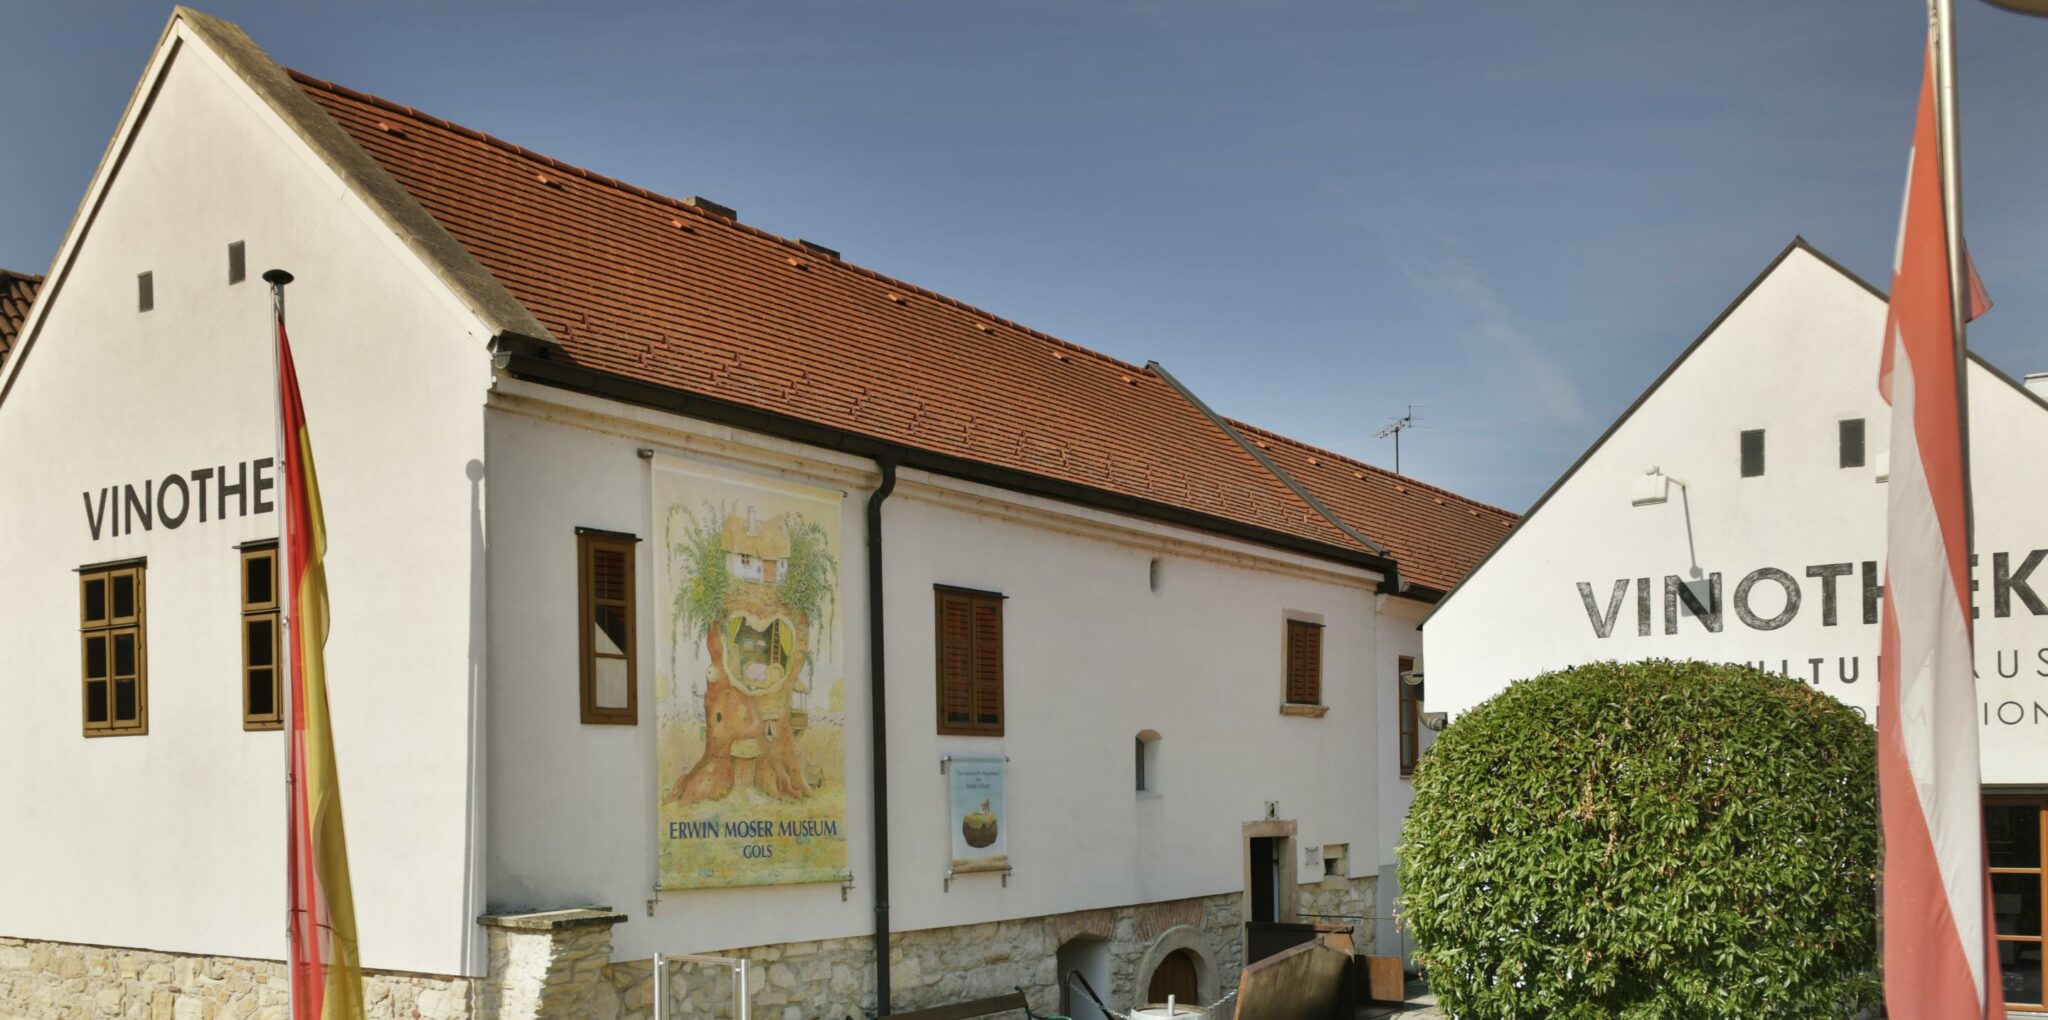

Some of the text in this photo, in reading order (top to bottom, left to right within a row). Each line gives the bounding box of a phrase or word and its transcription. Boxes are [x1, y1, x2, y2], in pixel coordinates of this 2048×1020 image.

[1576, 548, 2048, 639] VINOTK
[669, 819, 837, 839] ERWIN MOSER MUSEUM
[743, 844, 773, 859] GOLS
